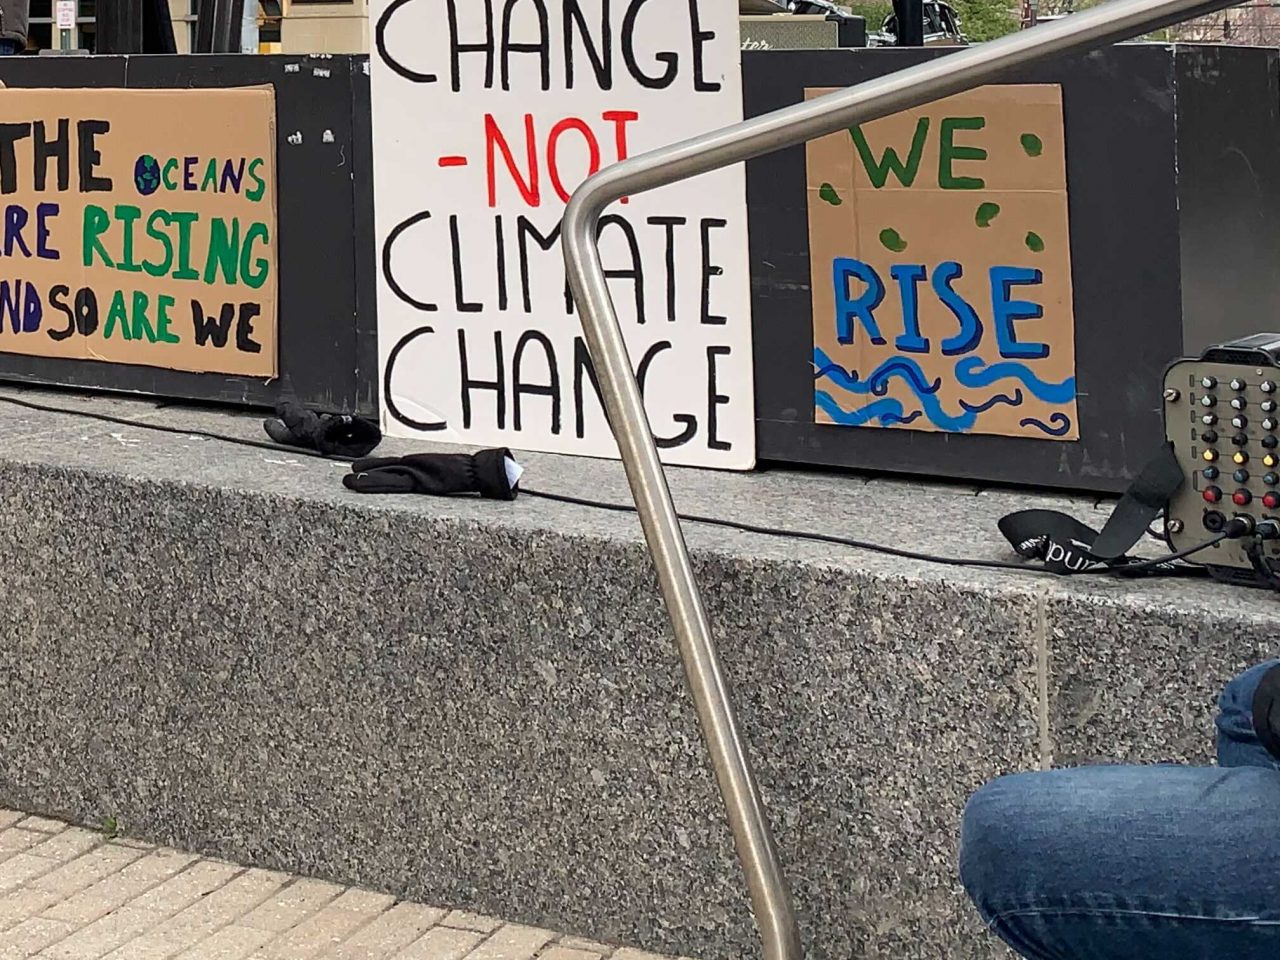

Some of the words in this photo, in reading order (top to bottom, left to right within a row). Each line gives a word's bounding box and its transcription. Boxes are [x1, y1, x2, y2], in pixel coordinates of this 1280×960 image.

[134, 154, 265, 202] OCEANS
[849, 117, 988, 190] WE
[82, 204, 269, 289] RISING
[382, 210, 728, 326] CLIMATE
[47, 284, 99, 343] SO
[104, 289, 180, 343] ARE
[190, 298, 262, 352] WE
[832, 257, 1050, 359] RISE
